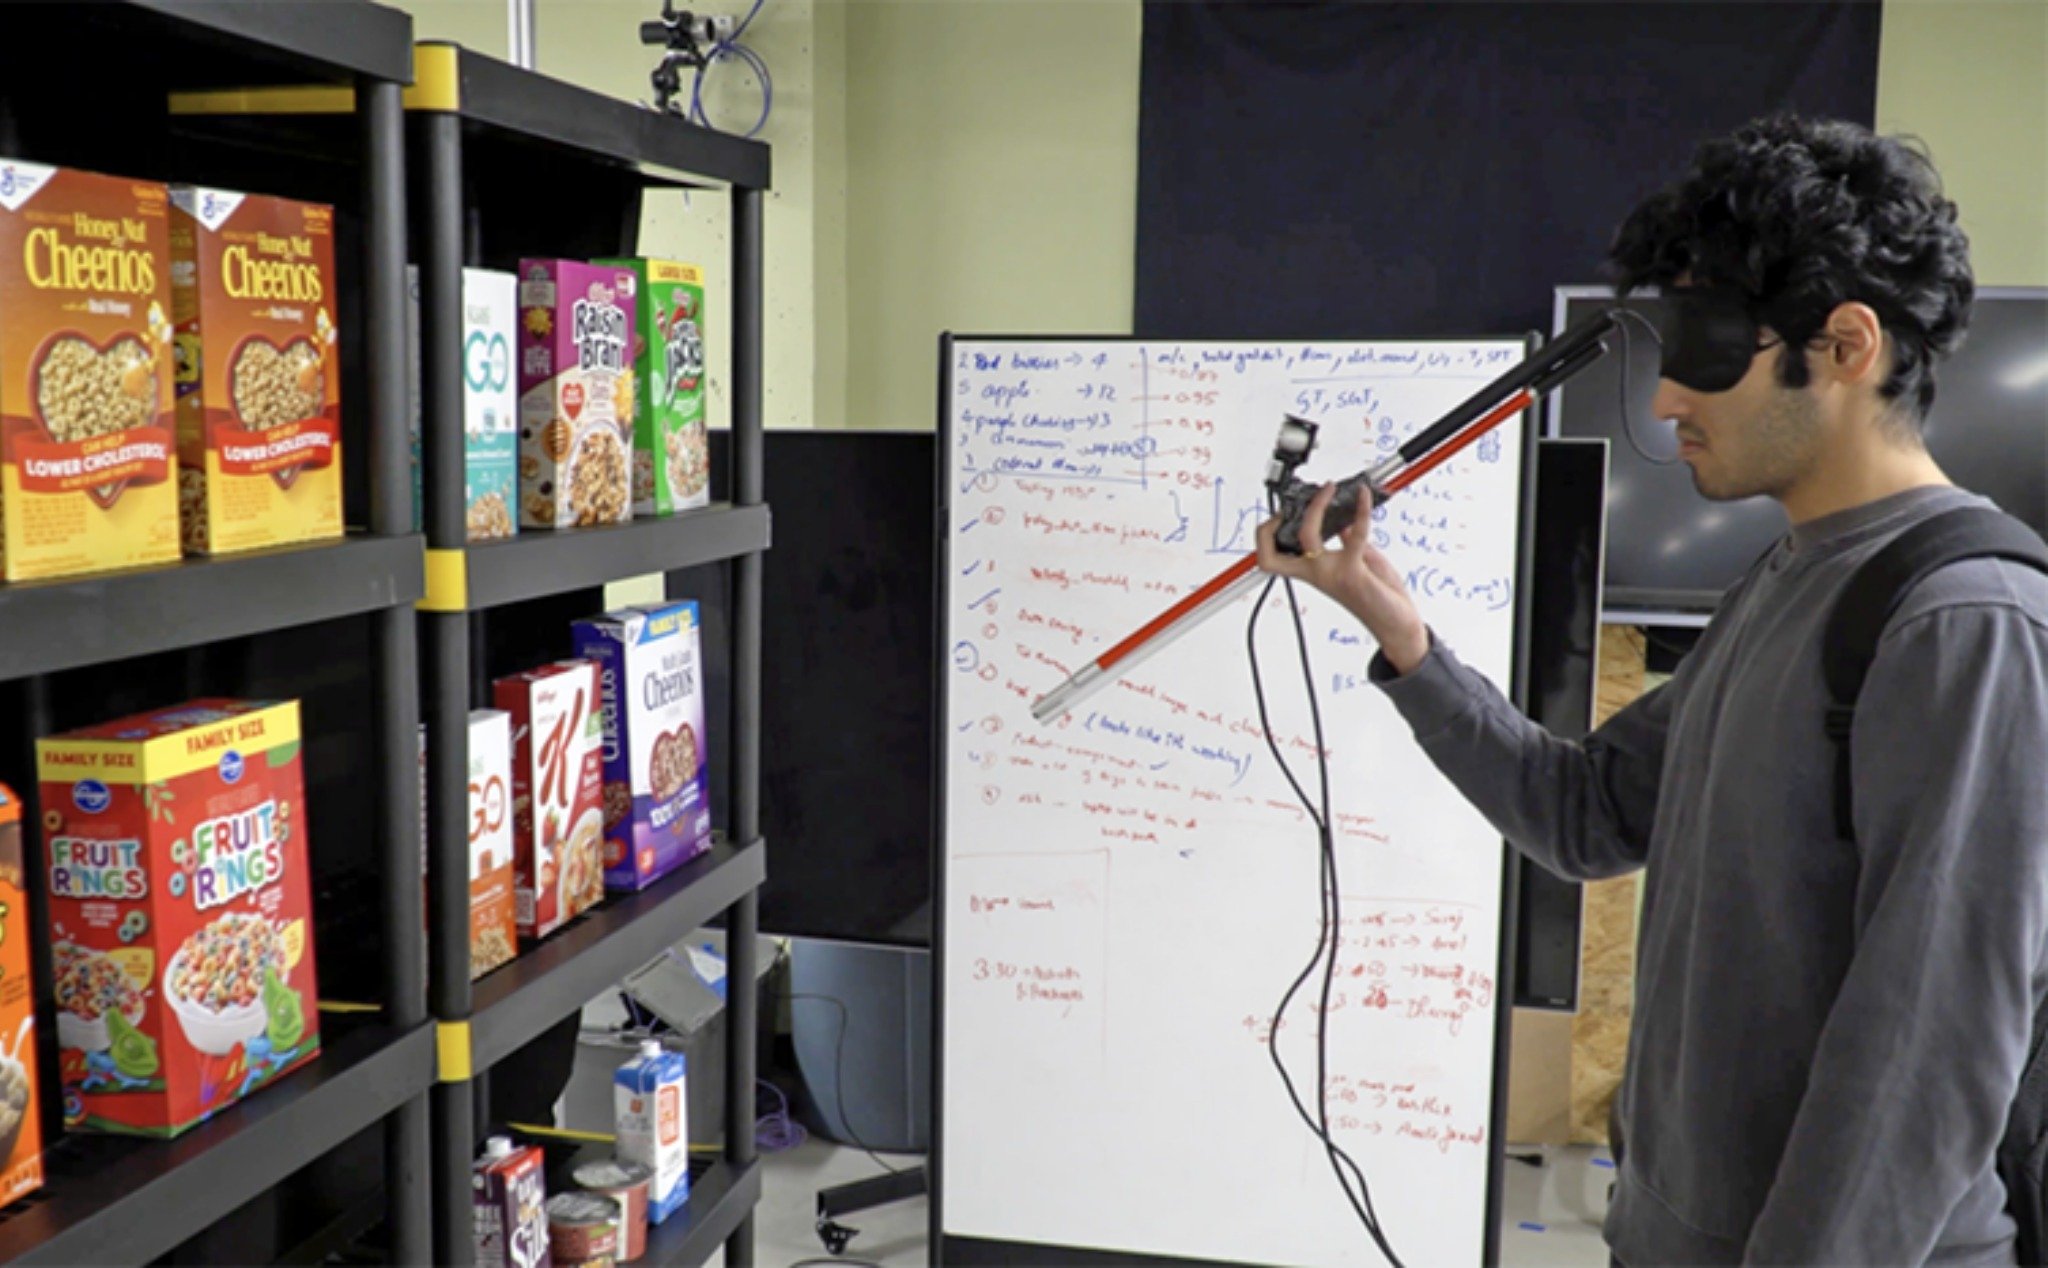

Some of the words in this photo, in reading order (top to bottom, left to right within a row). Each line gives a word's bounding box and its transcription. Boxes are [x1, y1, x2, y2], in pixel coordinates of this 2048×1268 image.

[74, 211, 119, 240] Honey
[121, 217, 147, 243] Nut
[24, 227, 156, 295] Cheerios
[221, 244, 323, 303] Cheerios
[580, 336, 622, 373] Bran
[25, 455, 82, 478] LOWER
[83, 442, 167, 472] CHOLESTEROL
[223, 442, 268, 462] LOWER
[267, 431, 332, 457] CHOLESTEROL
[643, 666, 694, 711] Cheerios
[186, 725, 234, 754] FAMILY
[238, 718, 265, 741] SIZE
[538, 687, 585, 808] K
[44, 751, 98, 767] FAMILY
[102, 752, 135, 768] SIZE
[195, 801, 275, 864] FRUIT
[52, 838, 140, 868] FRUIT
